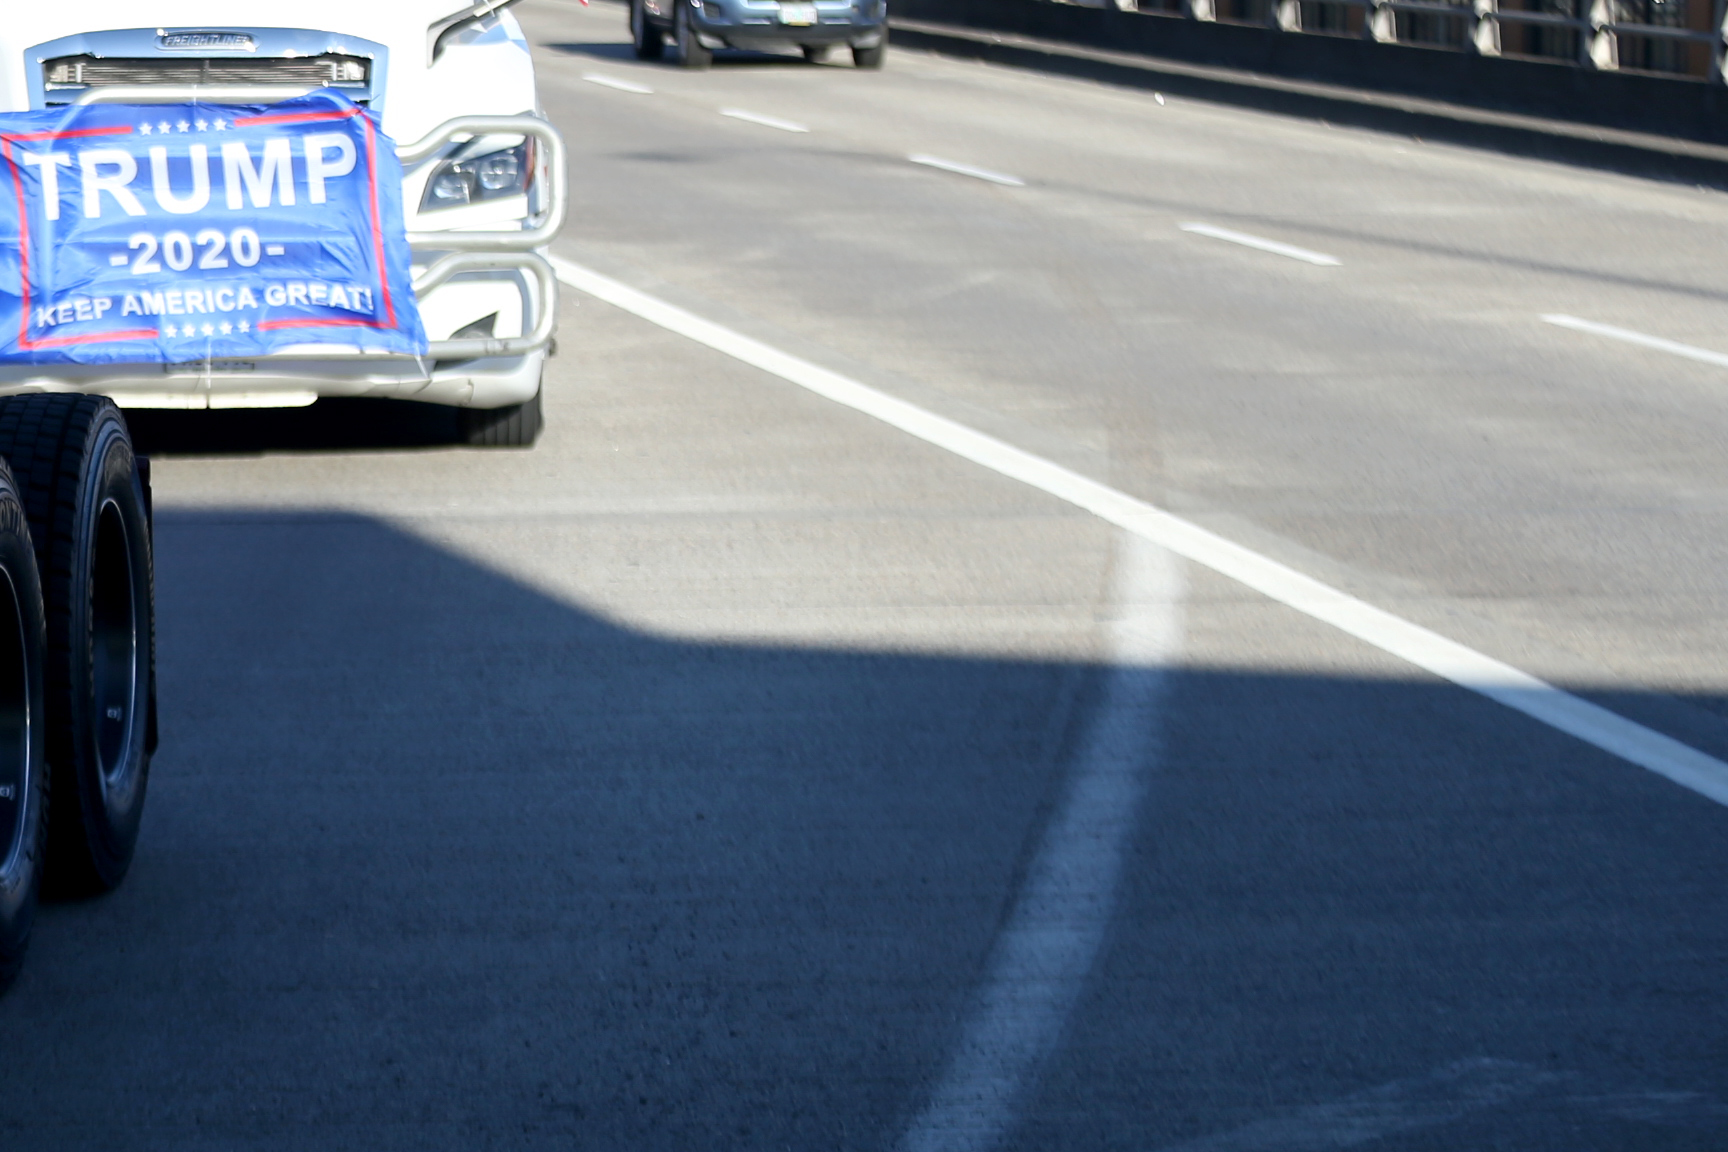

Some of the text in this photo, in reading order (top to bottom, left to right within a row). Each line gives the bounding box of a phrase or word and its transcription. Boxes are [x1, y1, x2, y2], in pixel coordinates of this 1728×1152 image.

[164, 34, 248, 46] FREIGHTLINER
[22, 132, 358, 221] TRUMP
[35, 282, 375, 328] KEEP AMERICA GREAT!
